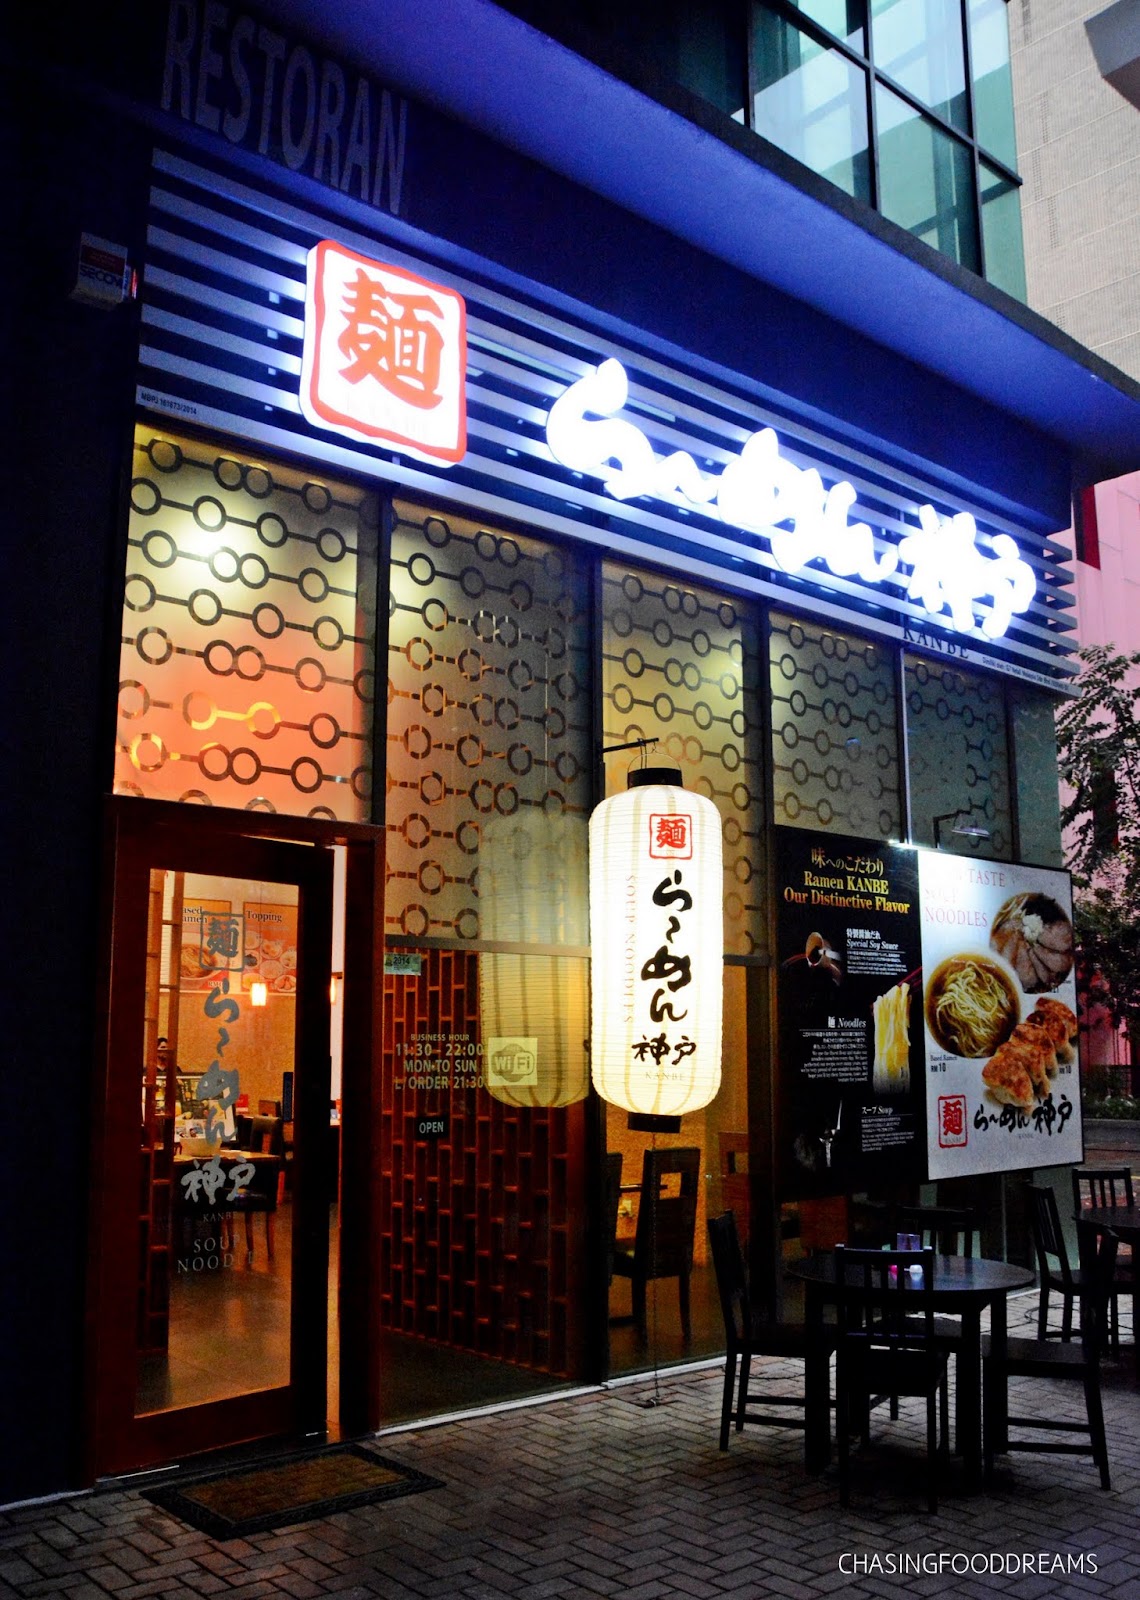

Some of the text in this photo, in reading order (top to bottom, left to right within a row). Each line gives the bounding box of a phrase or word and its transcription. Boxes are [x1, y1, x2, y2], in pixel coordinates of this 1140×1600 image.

[160, 0, 408, 216] RESTORAN
[338, 267, 444, 410] 麺
[656, 818, 687, 849] 麺
[811, 847, 884, 877] 味へのこだわり
[803, 870, 889, 895] Ramen KANBE
[968, 868, 1006, 888] TASTE
[182, 905, 203, 915] ased
[783, 886, 911, 914] Our Distinctive Flavor
[182, 915, 208, 924] amen
[246, 910, 282, 923] Topping
[925, 906, 988, 928] NOODLES
[846, 938, 899, 950] Special Soy Sauce
[837, 1017, 867, 1029] Noodles
[410, 1033, 446, 1042] BUSINESS
[396, 1043, 432, 1056] 11:30
[445, 1043, 484, 1056] 22:00
[631, 1033, 697, 1066] 神戸
[404, 1059, 478, 1073] MON TO SUN
[453, 1076, 484, 1089] 21:30
[419, 1121, 444, 1134] OPEN
[943, 1100, 963, 1136] 麺
[181, 1154, 256, 1205] 神戸
